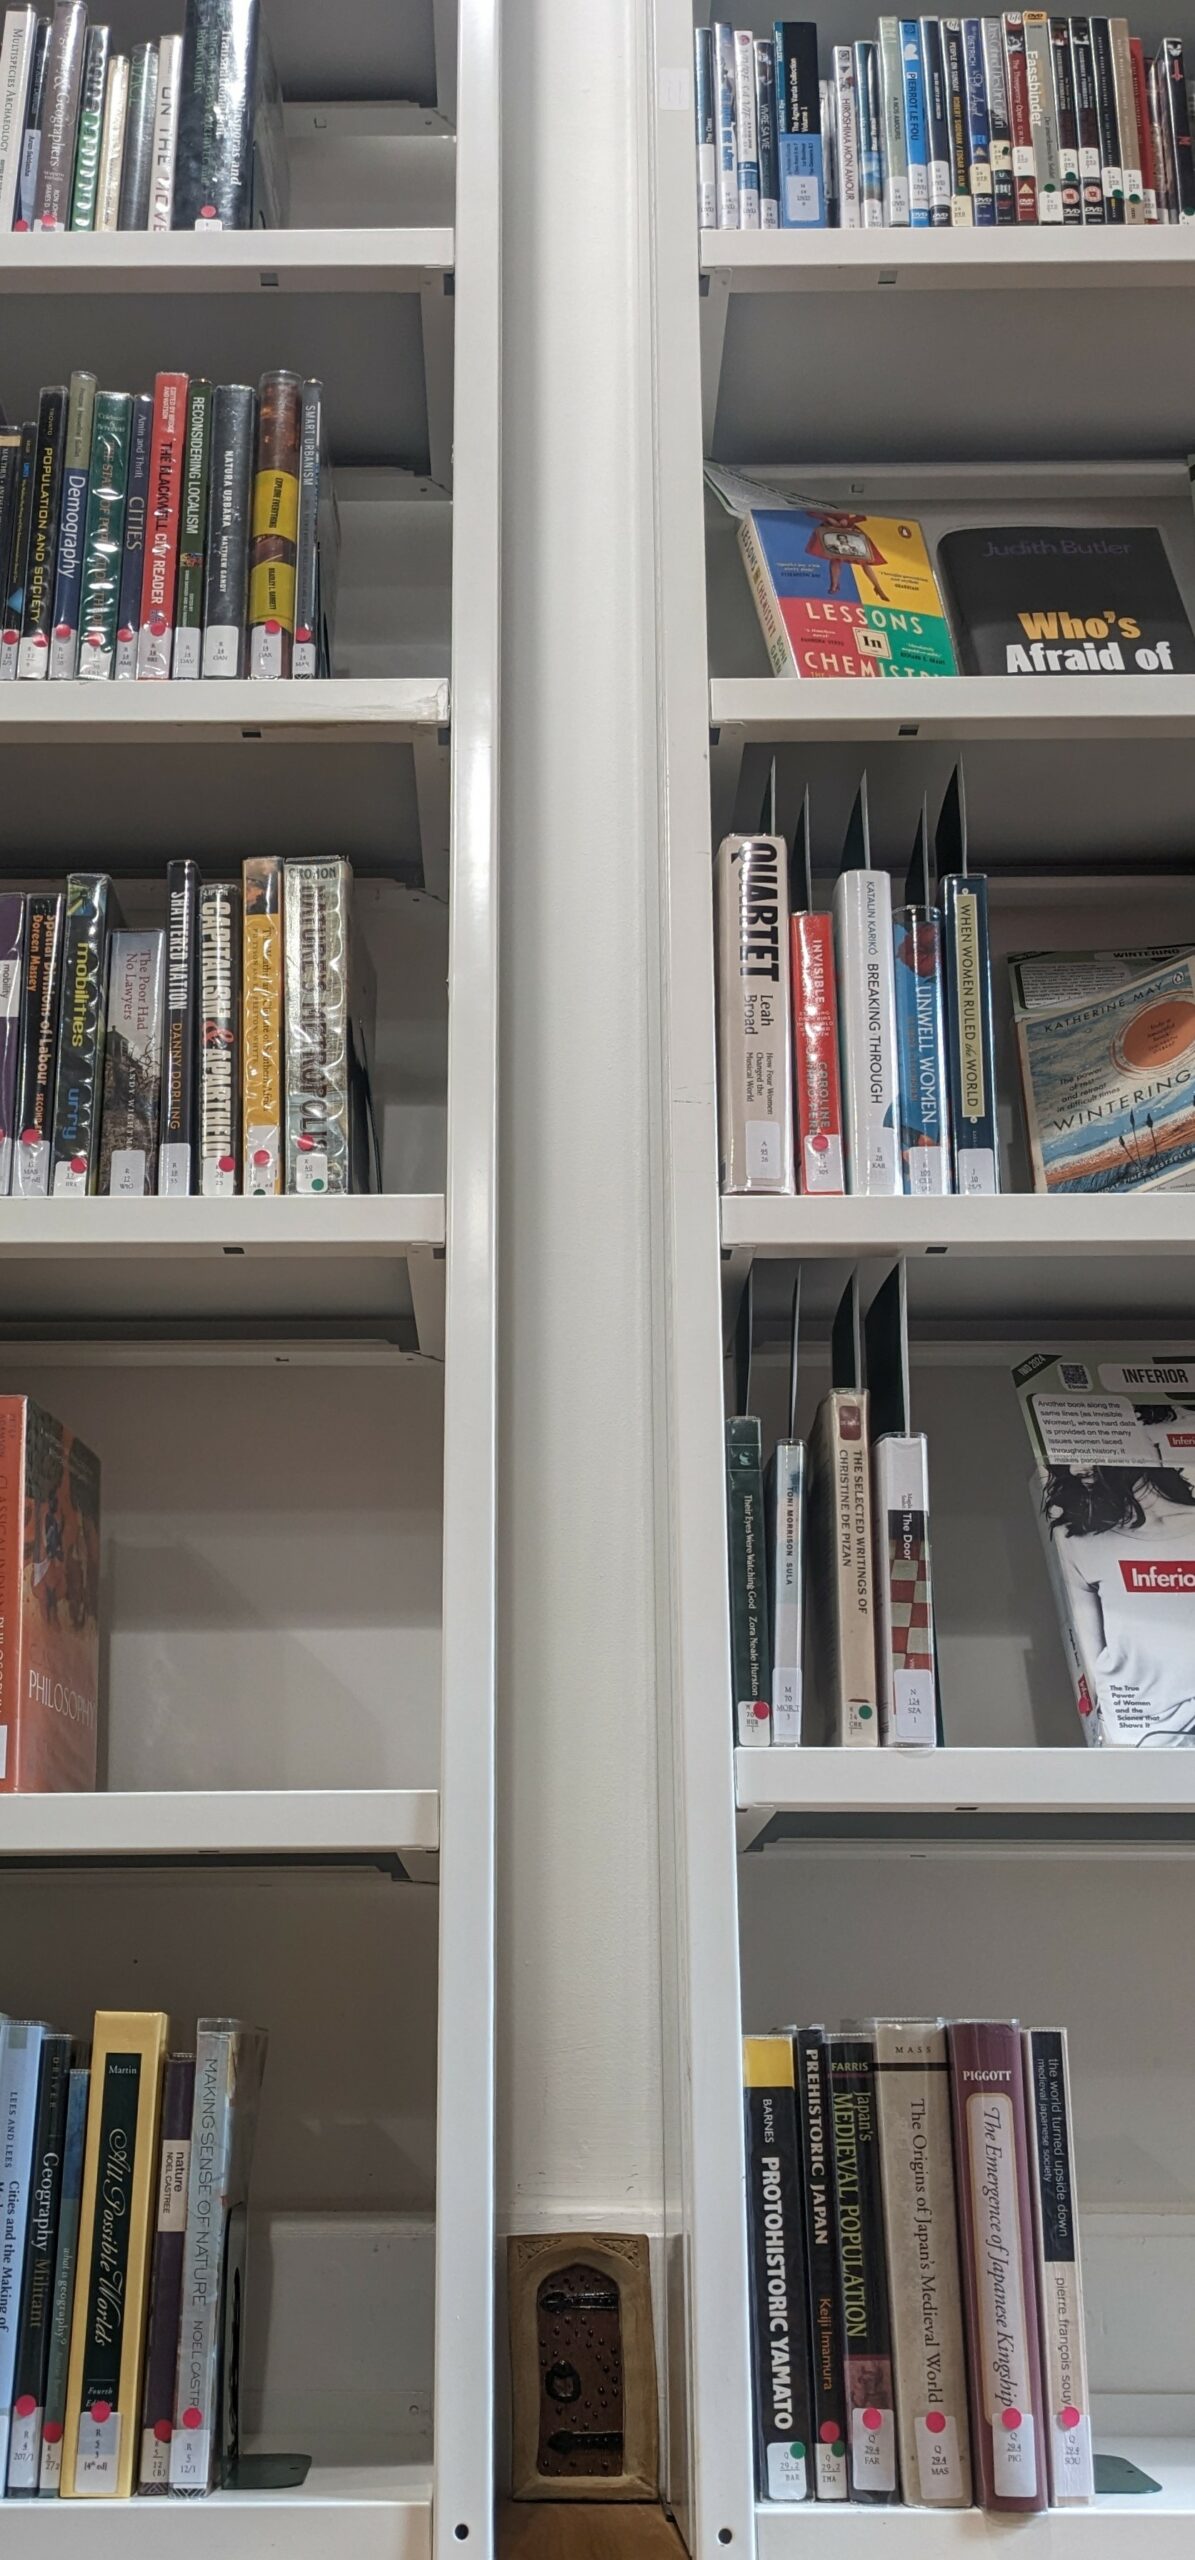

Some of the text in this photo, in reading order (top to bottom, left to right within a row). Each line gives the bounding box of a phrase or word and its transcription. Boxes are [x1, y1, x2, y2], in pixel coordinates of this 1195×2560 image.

[1, 29, 24, 152] MULTISPECIES ARCHAEOLOGY
[906, 72, 918, 106] PIERROT
[1026, 50, 1044, 126] Fassbinder
[842, 98, 855, 200] HIROSHIMA MON AMOUR
[910, 122, 920, 141] FOU
[231, 163, 241, 186] and
[161, 442, 172, 463] THE
[186, 396, 205, 534] RECONSIDERING LOCALISM
[303, 405, 315, 486] SMART URBANISM
[58, 475, 86, 579] Demography
[126, 497, 145, 551] CITIES
[156, 465, 171, 531] BLACKWELL
[30, 447, 53, 623] POPULATION AND SOCIETY
[982, 539, 1133, 558] Judith Butler
[151, 560, 166, 605] READER
[806, 602, 924, 635] LESSONS
[862, 635, 882, 649] In
[1017, 610, 1142, 640] Who's
[804, 652, 947, 677] CHEMIST
[1005, 641, 1174, 674] Afraid of
[731, 842, 780, 982] QUARTET
[866, 881, 879, 955] KATALIN KARIKÓ
[0, 963, 10, 999] mobility
[26, 914, 43, 992] Doreen Massey
[168, 891, 190, 1010] SHATTERED NATION
[202, 901, 231, 1018] CAPITALISM
[811, 939, 825, 1003] INVISIBLE
[71, 942, 90, 1047] mobilities
[121, 953, 138, 1020] No Lawyers
[136, 950, 150, 1030] The Poor Had
[744, 994, 758, 1035] Broad
[761, 994, 774, 1027] Leah
[961, 904, 979, 1107] WHEN WOMEN RULED the WORLD
[1045, 998, 1125, 1033] KATHERINE
[1133, 982, 1163, 1002] MAY
[867, 963, 883, 1104] BREAKING THROUGH
[916, 985, 937, 1124] UNWELL WOMEN
[170, 1022, 183, 1130] DANNY DORLING
[202, 1049, 232, 1158] APARTHEID
[818, 1061, 831, 1128] CAROLINE
[1053, 1069, 1192, 1131] WINTERING
[1061, 1083, 1107, 1103] and retreat
[1077, 1068, 1102, 1081] power
[62, 1087, 79, 1140] urry
[1122, 1368, 1189, 1383] INFERIOR
[786, 1510, 794, 1557] MORRISON
[839, 1450, 852, 1567] CHRISTINE DE PIZAN
[853, 1451, 868, 1614] THE SELECTED WRITINGS OF
[902, 1512, 913, 1532] The
[786, 1562, 794, 1586] SULA
[903, 1534, 913, 1561] Door
[1132, 1566, 1195, 1587] Inferio
[744, 1495, 760, 1696] Their Eyes Were Watching God Zora Neale Hurston
[29, 1669, 97, 1730] PHILOSOPHY
[108, 2064, 137, 2075] Martin
[831, 2062, 869, 2072] FARRIS
[963, 2070, 1012, 2081] PIGGOTT
[5, 2092, 18, 2168] LEES AND LEES
[853, 2091, 872, 2142] Japan's
[1037, 2058, 1053, 2183] medieval japanese society
[1048, 2058, 1069, 2237] the world turned upside down
[163, 2152, 173, 2214] NOEL CASTREE
[173, 2151, 185, 2192] nature
[30, 2152, 60, 2328] Geography Militant
[95, 2128, 131, 2347] All Possible Worlds
[190, 2058, 218, 2409] MAKING SENSE OF NATURE NOEL CASTR
[806, 2049, 833, 2390] PREHISTORIC JAPAN Keiji Imamura
[833, 2092, 867, 2338] MEDIEVAL POPULATION
[0, 2180, 20, 2333] Cities and the Making of
[761, 2098, 793, 2430] BARNES PROTOHISTORIC YAMATO
[909, 2098, 943, 2403] The Origins of Japan's Medieval World
[982, 2106, 1018, 2407] The Emergence of Japanese Kingship
[1055, 2277, 1072, 2407] pierre françois souy
[87, 2386, 113, 2395] Fourth
[821, 2463, 841, 2471] 29.2
[864, 2456, 880, 2465] FAR
[931, 2467, 949, 2475] MAS
[1007, 2454, 1022, 2463] PIG
